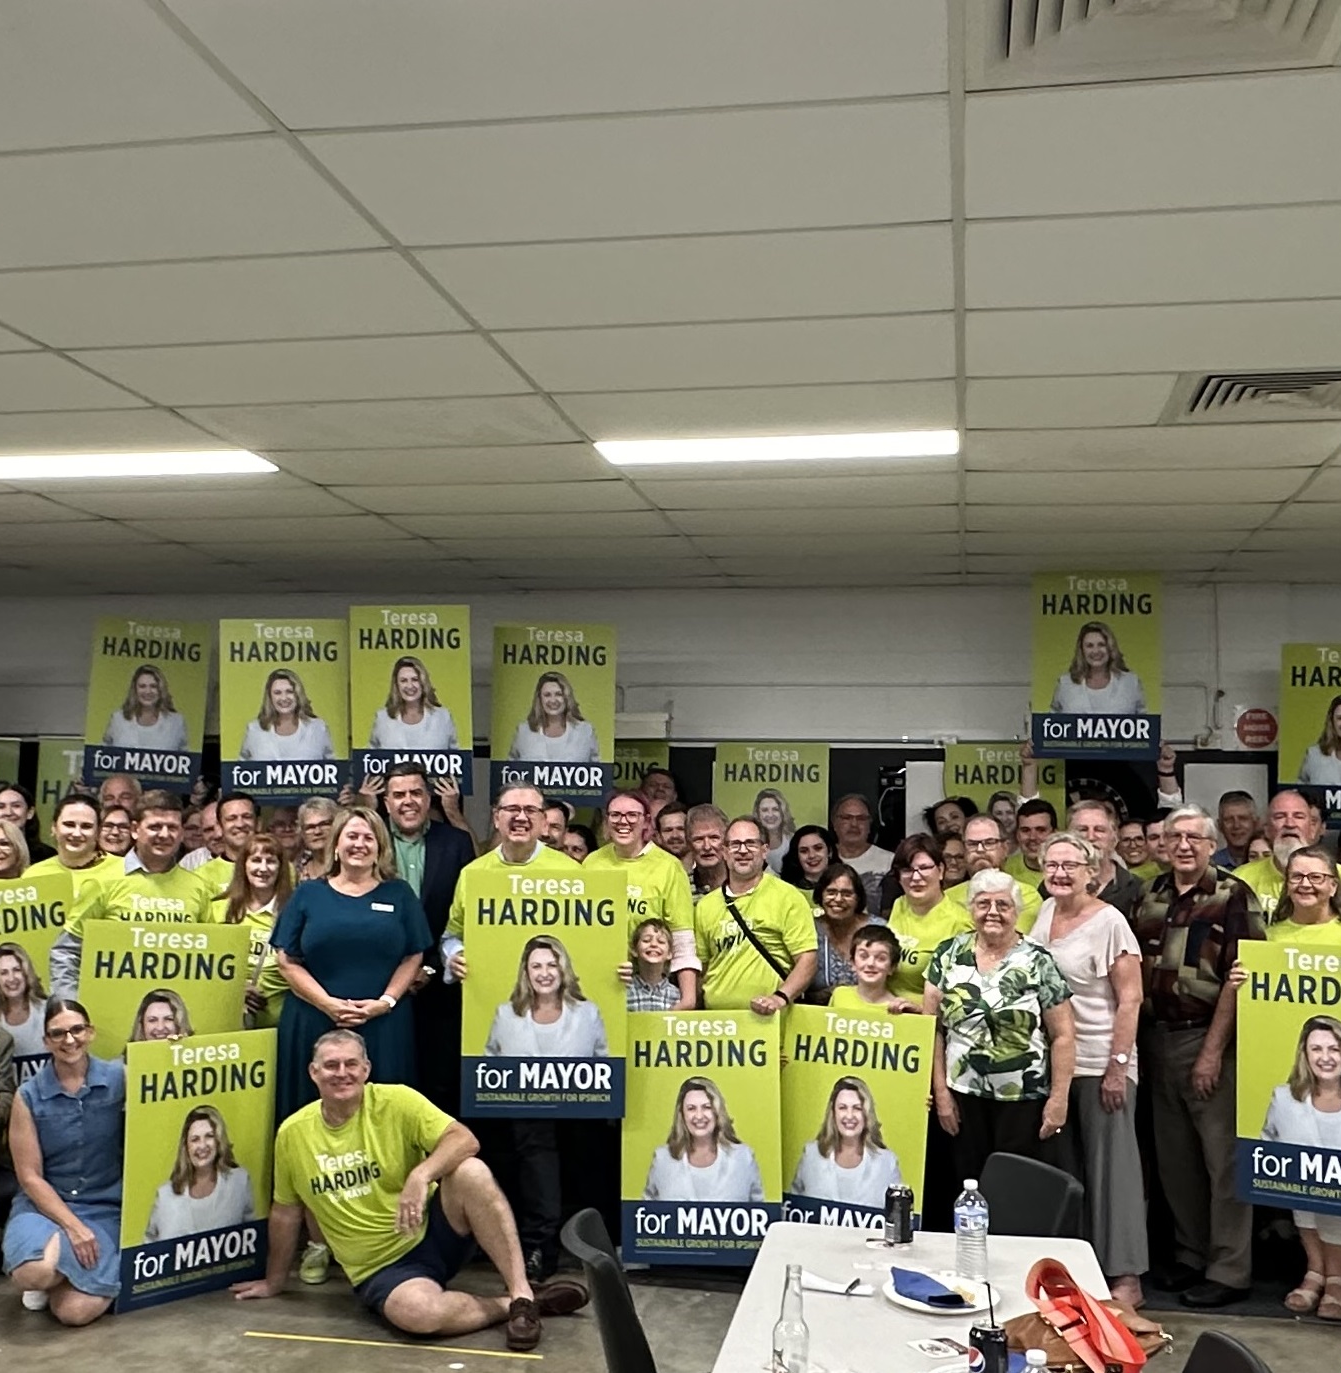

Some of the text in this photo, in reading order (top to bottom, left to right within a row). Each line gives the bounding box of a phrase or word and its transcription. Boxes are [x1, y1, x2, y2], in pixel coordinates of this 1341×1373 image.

[1067, 576, 1128, 591] Teresa
[1042, 594, 1152, 615] HARDING
[381, 610, 438, 626] Teresa
[127, 621, 181, 640] Teresa
[254, 622, 314, 640] Teresa
[359, 628, 461, 650] HARDING
[526, 627, 584, 643] Teresa
[102, 636, 201, 662] HARDING
[229, 641, 337, 662] HARDING
[502, 644, 607, 667] HARDING
[1043, 718, 1150, 739] for MAYOR
[94, 750, 121, 770] for
[124, 752, 191, 775] MAYOR
[362, 753, 390, 774] for
[746, 747, 799, 762] Teresa
[975, 748, 1022, 762] Teres
[232, 764, 338, 786] for MAYOR
[501, 766, 529, 785] for
[534, 766, 603, 787] MAYOR
[724, 763, 820, 783] HARDING
[955, 764, 1056, 785] HARDIG
[508, 874, 585, 896] Teresa
[130, 893, 185, 911] Teresa
[477, 898, 615, 927] HARDING
[130, 927, 208, 950] Teresa
[95, 950, 236, 980] HARDING
[663, 1016, 737, 1037] Teresa
[825, 1012, 894, 1039] Teresa
[170, 1042, 240, 1066] Teresa
[634, 1039, 767, 1068] HARDING
[793, 1033, 920, 1074] HARDING
[140, 1060, 266, 1104] HARDING
[476, 1062, 612, 1090] for MAYOR
[1252, 1146, 1293, 1178] for
[311, 1161, 381, 1196] HARDING
[1252, 1178, 1307, 1195] SUSTAINABLE
[635, 1207, 769, 1237] for MAYOR
[819, 1205, 886, 1229] MAYO
[133, 1228, 258, 1280] for MAYOR
